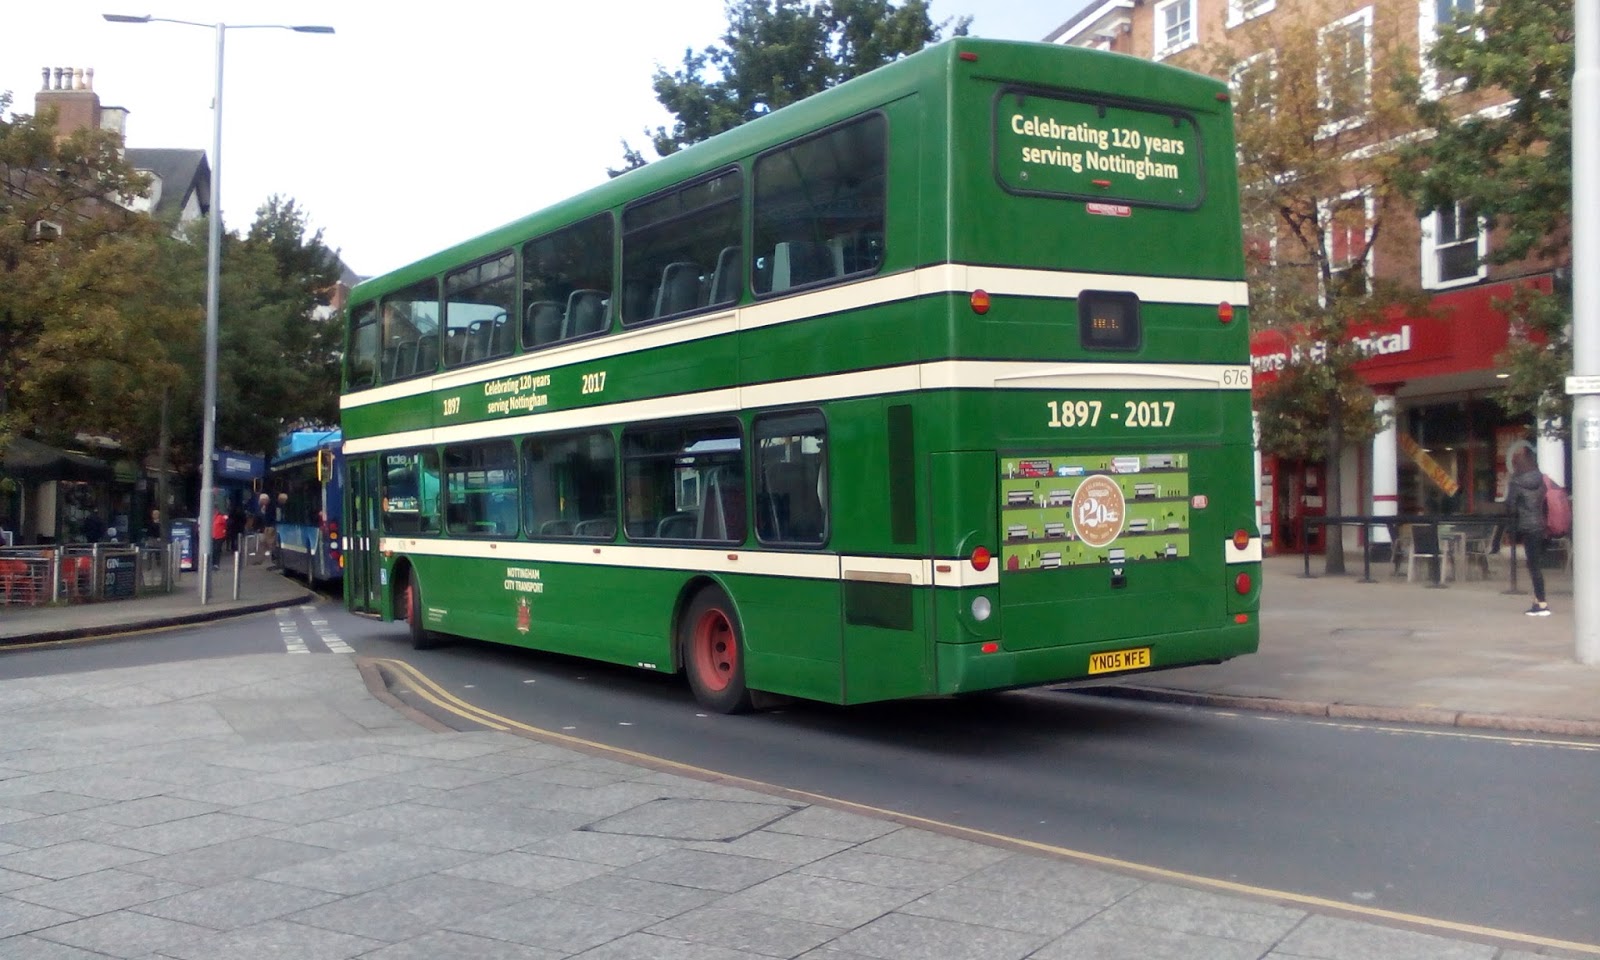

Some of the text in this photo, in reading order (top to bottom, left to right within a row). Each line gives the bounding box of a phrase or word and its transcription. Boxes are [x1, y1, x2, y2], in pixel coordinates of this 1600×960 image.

[1011, 114, 1185, 155] Celebrating 120 years
[1022, 145, 1179, 181] serving Nottingham
[484, 374, 551, 396] Celebrating 120 years
[582, 371, 607, 394] 2017
[1223, 369, 1248, 386] 676
[443, 397, 461, 416] 1897
[487, 393, 548, 414] serving Nottingham
[1047, 400, 1102, 427] 1897
[1124, 400, 1176, 427] 2017
[507, 567, 540, 579] NOTTINGHAM
[504, 579, 544, 593] CITY TRANSPORT
[1092, 651, 1145, 670] YN05 WFE
